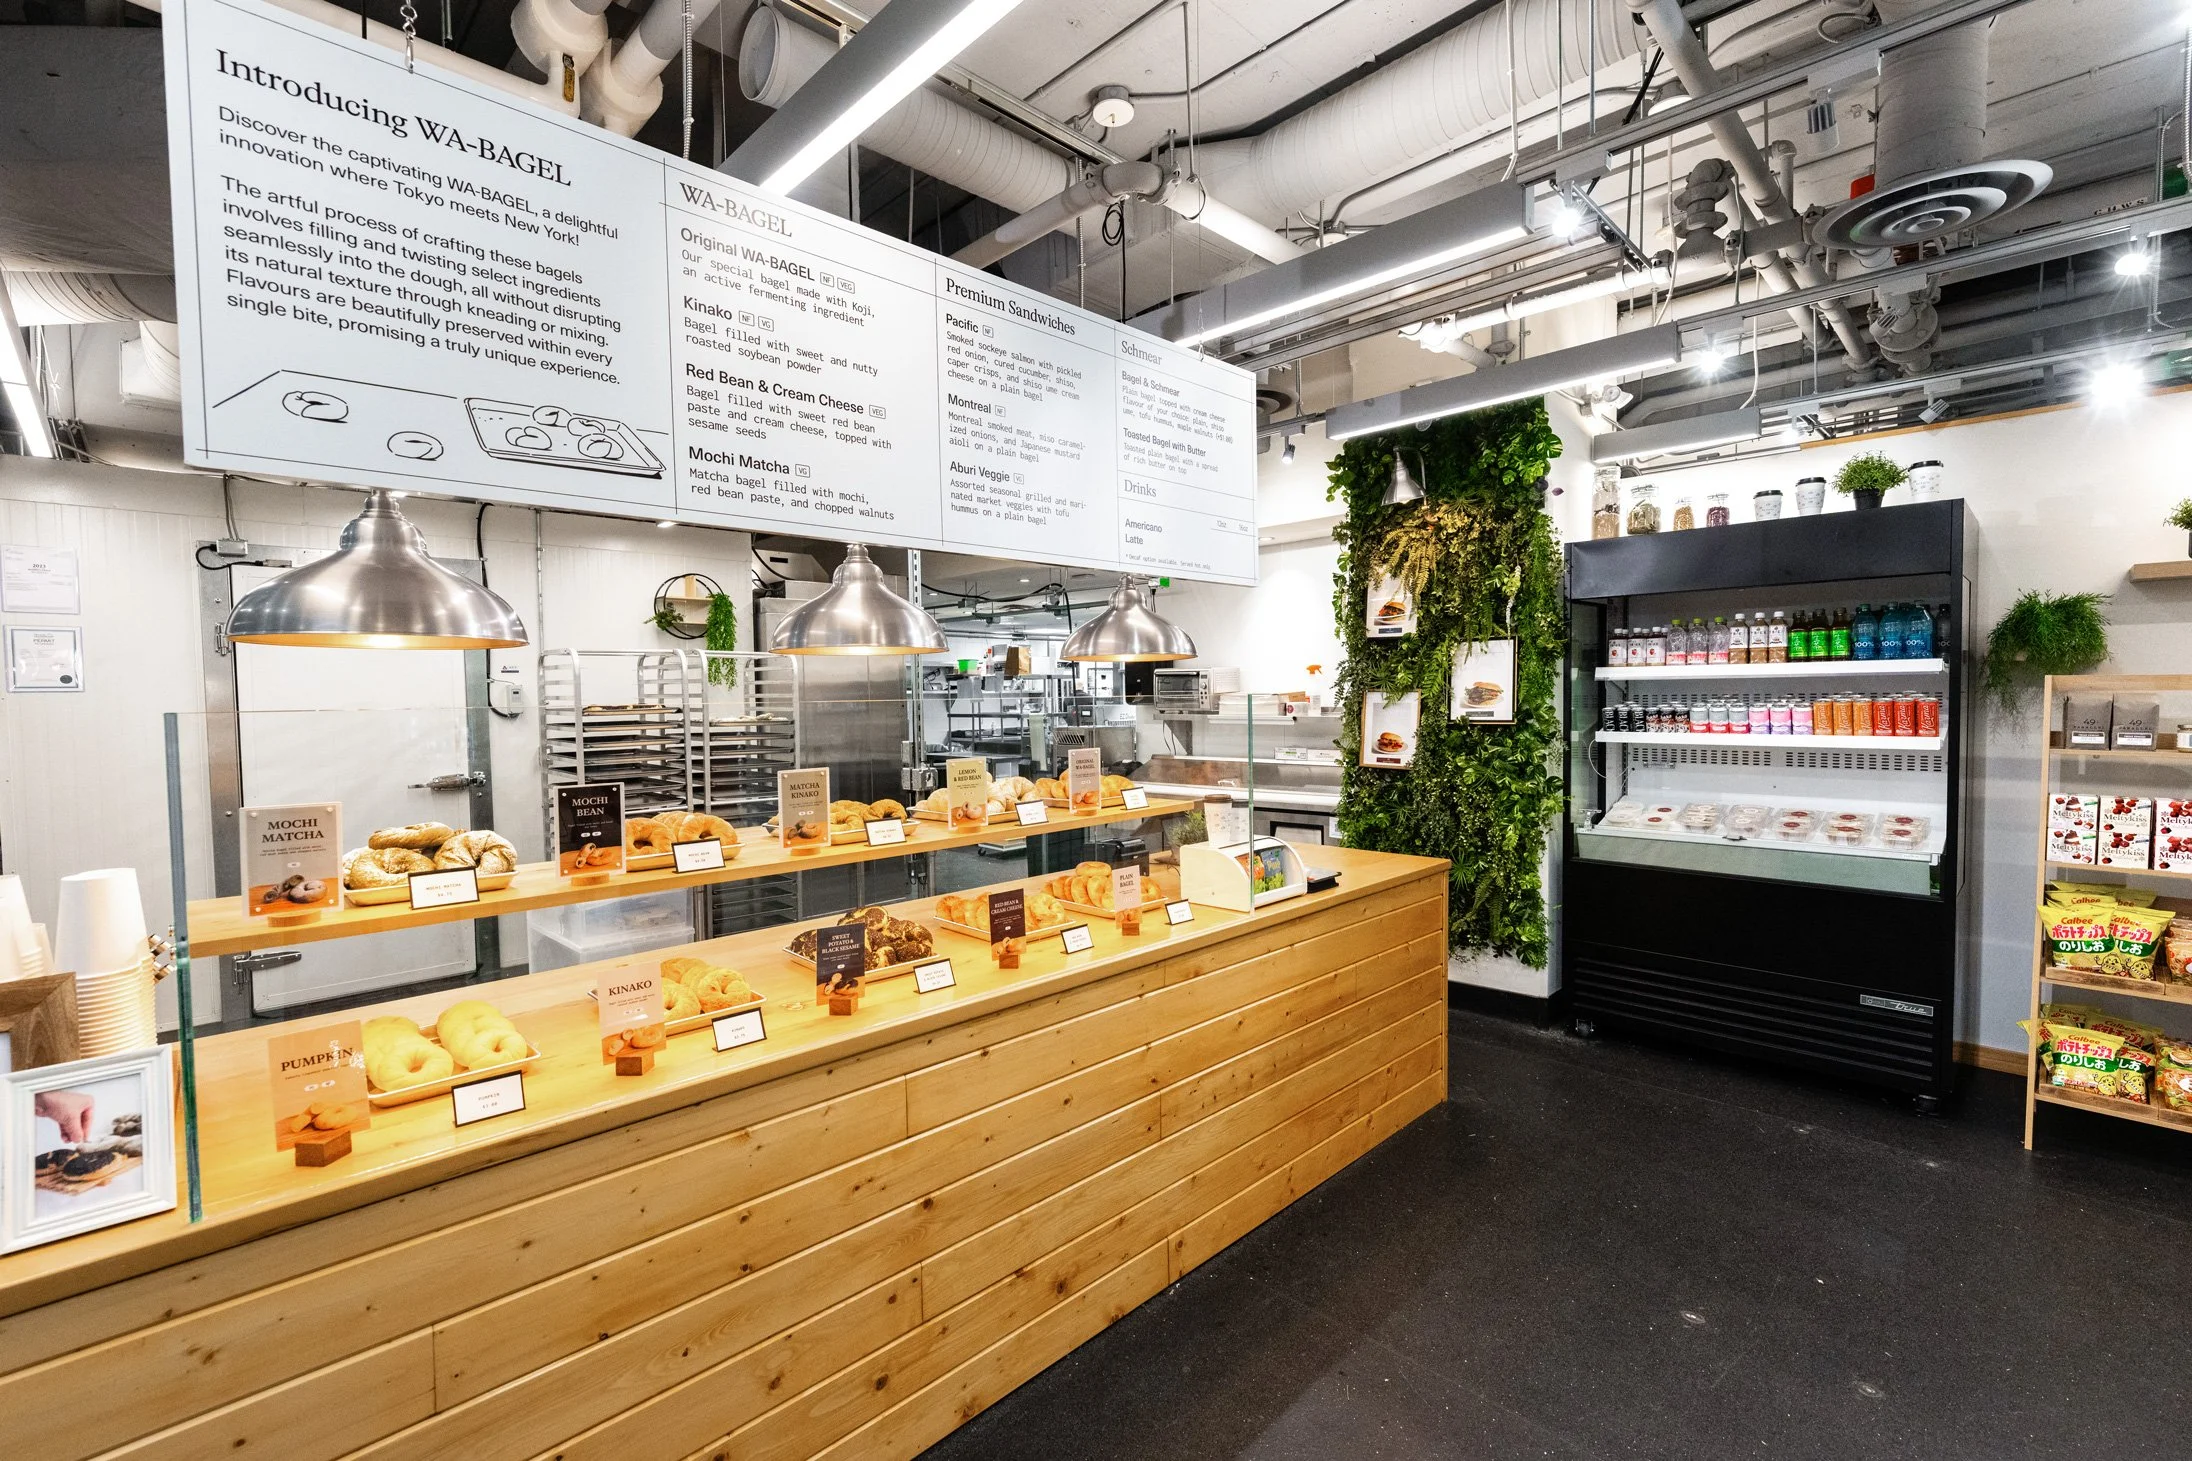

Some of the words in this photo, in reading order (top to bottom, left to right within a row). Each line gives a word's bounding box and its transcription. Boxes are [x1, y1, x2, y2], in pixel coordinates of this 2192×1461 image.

[216, 48, 408, 138] Introducing
[414, 115, 571, 186] WA-BAGEL
[219, 105, 307, 144] Discover
[312, 136, 342, 156] the
[348, 149, 442, 189] captivating
[446, 175, 538, 217] WA-BAGEL,
[542, 208, 550, 219] a
[554, 211, 618, 239] delightful
[220, 128, 323, 172] innovation
[330, 164, 388, 190] where
[392, 179, 444, 206] Tokyo
[450, 200, 500, 223] meets
[504, 213, 539, 234] New
[543, 224, 579, 246] York!
[679, 181, 792, 237] WA-BAGEL
[221, 174, 261, 198] The
[267, 191, 318, 214] artful
[325, 207, 397, 235] process
[402, 227, 418, 240] of
[423, 233, 485, 261] crafting
[489, 249, 531, 270] these
[536, 260, 583, 284] bagels
[223, 199, 303, 232] involves
[309, 221, 357, 248] filling
[363, 238, 396, 255] and
[401, 246, 466, 276] twisting
[471, 266, 518, 286] select
[522, 274, 601, 307] ingredients
[680, 227, 737, 256] Original
[740, 246, 815, 281] WA-BAGEL
[823, 276, 831, 284] NF
[840, 282, 853, 291] VEG
[224, 225, 333, 263] seamlessly
[339, 248, 372, 270] into
[377, 261, 405, 278] the
[410, 269, 467, 295] dough,
[471, 285, 488, 298] all
[492, 291, 549, 313] without
[552, 304, 621, 333] disrupting
[683, 295, 732, 320] Kinako
[742, 314, 751, 323] NF
[761, 320, 771, 329] VG
[946, 277, 1005, 311] Premium
[1008, 299, 1075, 335] Sandwiches
[946, 313, 979, 333] Pacific
[684, 316, 717, 334] Bagel
[725, 327, 760, 345] filled
[766, 339, 790, 353] with
[796, 348, 824, 362] sweet
[830, 356, 847, 367] and
[852, 362, 878, 377] nutty
[686, 334, 731, 352] roasted
[738, 347, 781, 365] soybean
[787, 359, 821, 374] powder
[946, 330, 974, 347] Smoked
[978, 342, 1007, 357] sockeye
[1010, 352, 1035, 365] salmon
[1038, 360, 1054, 371] with
[1056, 365, 1082, 379] pickled
[1121, 340, 1162, 365] Schmear
[686, 362, 714, 381] Red
[719, 370, 754, 390] Bean
[758, 379, 769, 393] &
[772, 383, 815, 404] Cream
[818, 393, 864, 414] Cheese
[872, 408, 884, 417] VEG
[1121, 370, 1142, 385] Bagel
[1142, 377, 1149, 387] &
[1150, 379, 1180, 397] Schmear
[948, 393, 991, 414] Montreal
[1122, 427, 1151, 443] Toasted
[1152, 435, 1171, 448] Bagel
[1171, 441, 1186, 452] with
[1187, 444, 1206, 457] Butter
[689, 445, 734, 465] Mochi
[739, 454, 790, 474] Matcha
[798, 467, 807, 476] VG
[949, 460, 976, 475] Aburi
[978, 466, 1010, 483] Veggie
[689, 467, 729, 483] Matcha
[735, 474, 766, 489] bagel
[774, 479, 807, 494] filled
[812, 486, 834, 498] with
[838, 492, 869, 505] mochi,
[1124, 479, 1157, 497] Drinks
[691, 484, 711, 495] red
[717, 485, 744, 500] bean
[750, 493, 784, 507] paste,
[790, 498, 809, 508] and
[814, 500, 854, 514] chopped
[858, 507, 895, 520] walnuts
[1124, 518, 1163, 533] Americano
[1125, 533, 1143, 545] Latte
[1854, 640, 1874, 648] 100%
[958, 768, 977, 776] LEMON
[789, 782, 820, 791] MATCHA
[791, 790, 819, 800] KINAKO
[572, 796, 609, 807] MOCHI
[576, 807, 605, 818] BEAN
[268, 818, 318, 830] MOCHI
[2104, 813, 2147, 822] Meltykiss
[262, 830, 324, 844] MATCHA
[2102, 847, 2145, 857] Meltykiss
[2052, 925, 2108, 938] ポテトチップス
[2061, 917, 2093, 925] Calbee
[2059, 940, 2105, 952] のりしお
[608, 980, 652, 996] KINAKO
[2057, 1039, 2113, 1059] ポテトチップス
[2068, 1034, 2100, 1044] Calbee
[281, 1047, 354, 1072] PUMPKIN
[2061, 1054, 2106, 1071] のりしお
